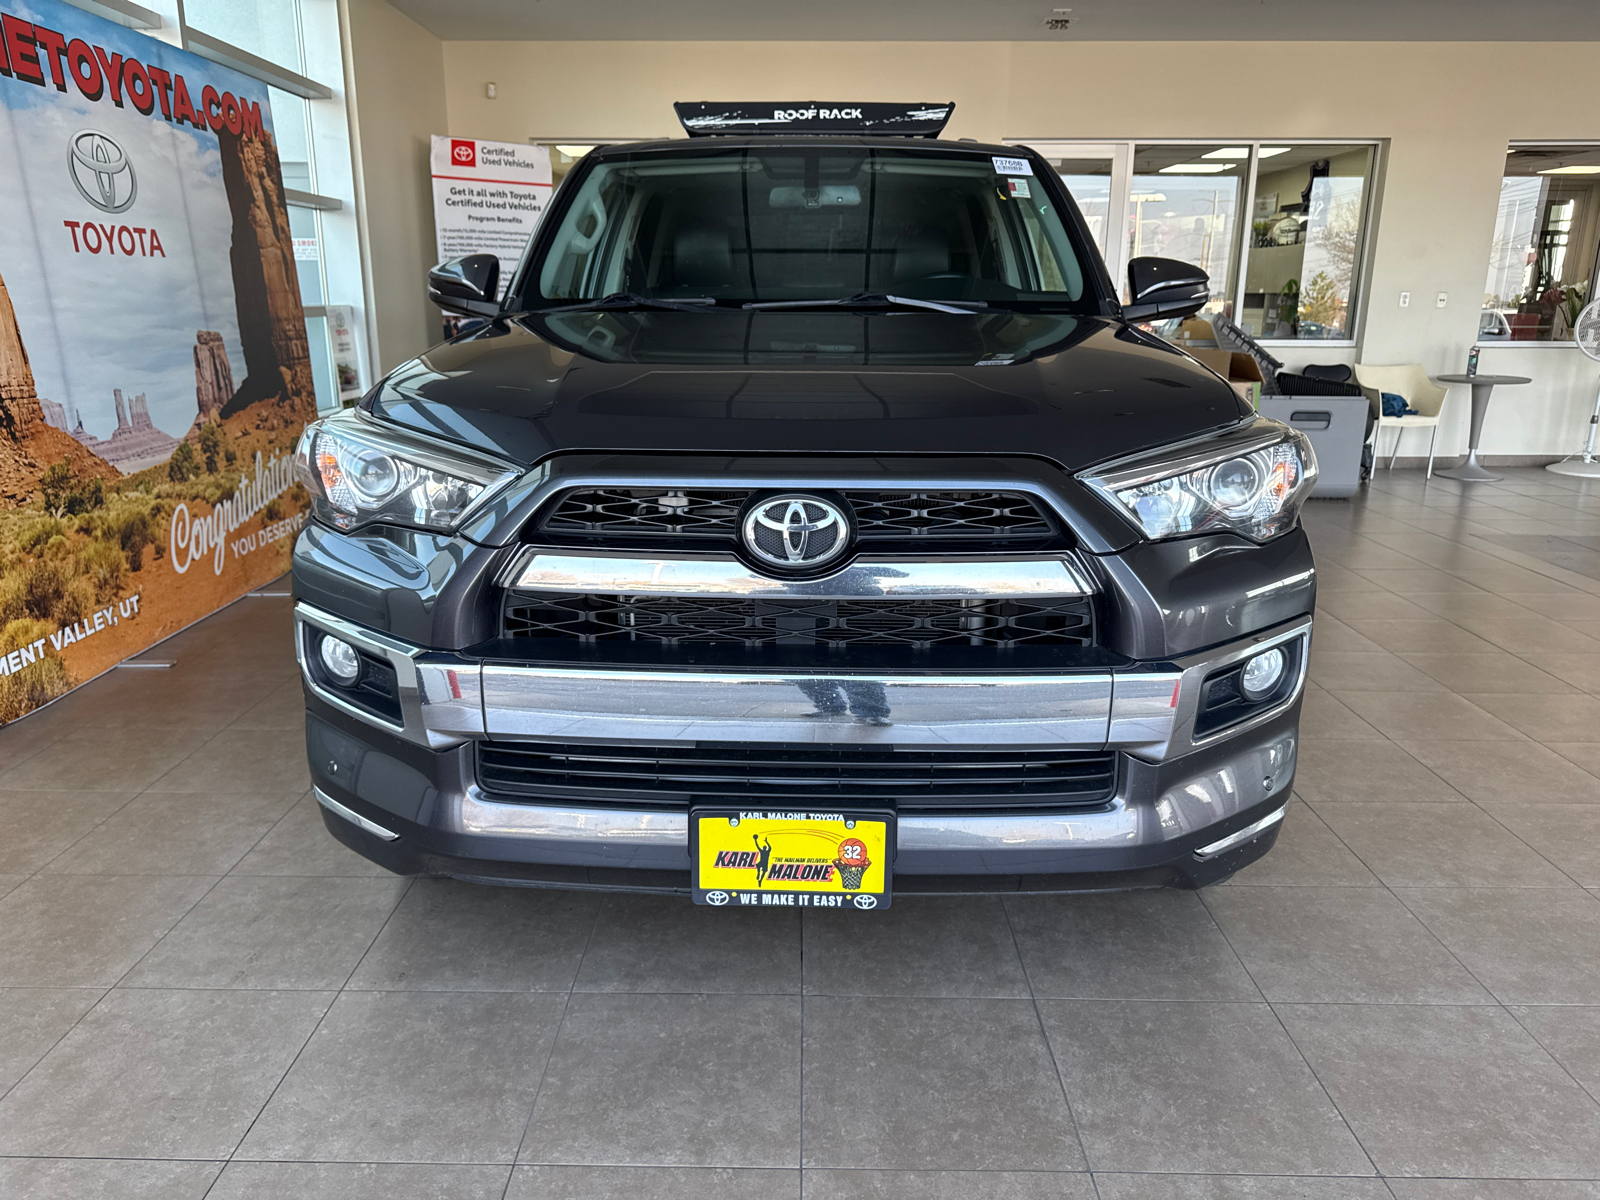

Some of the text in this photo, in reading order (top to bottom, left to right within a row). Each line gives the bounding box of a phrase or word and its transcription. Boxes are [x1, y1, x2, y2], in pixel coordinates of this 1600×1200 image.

[0, 12, 266, 142] ETOYOTA.COM
[774, 108, 862, 120] ROOF RACK
[481, 146, 515, 157] Certified
[481, 156, 535, 169] Used Vehicles
[450, 187, 537, 201] Get it all with Toyota
[445, 198, 542, 212] Certified Used Vehicles
[467, 214, 523, 224] Program Benefits
[63, 220, 166, 258] TOYOTA
[230, 513, 303, 558] YOU DESERVE
[49, 606, 118, 651] VALLEY,
[119, 594, 140, 618] UT
[739, 812, 844, 822] KARL MALONE TOYOTA
[844, 845, 861, 859] 32
[714, 850, 760, 869] KARL
[766, 863, 835, 882] MALONE
[740, 893, 843, 906] WE MAKE IT EASY
